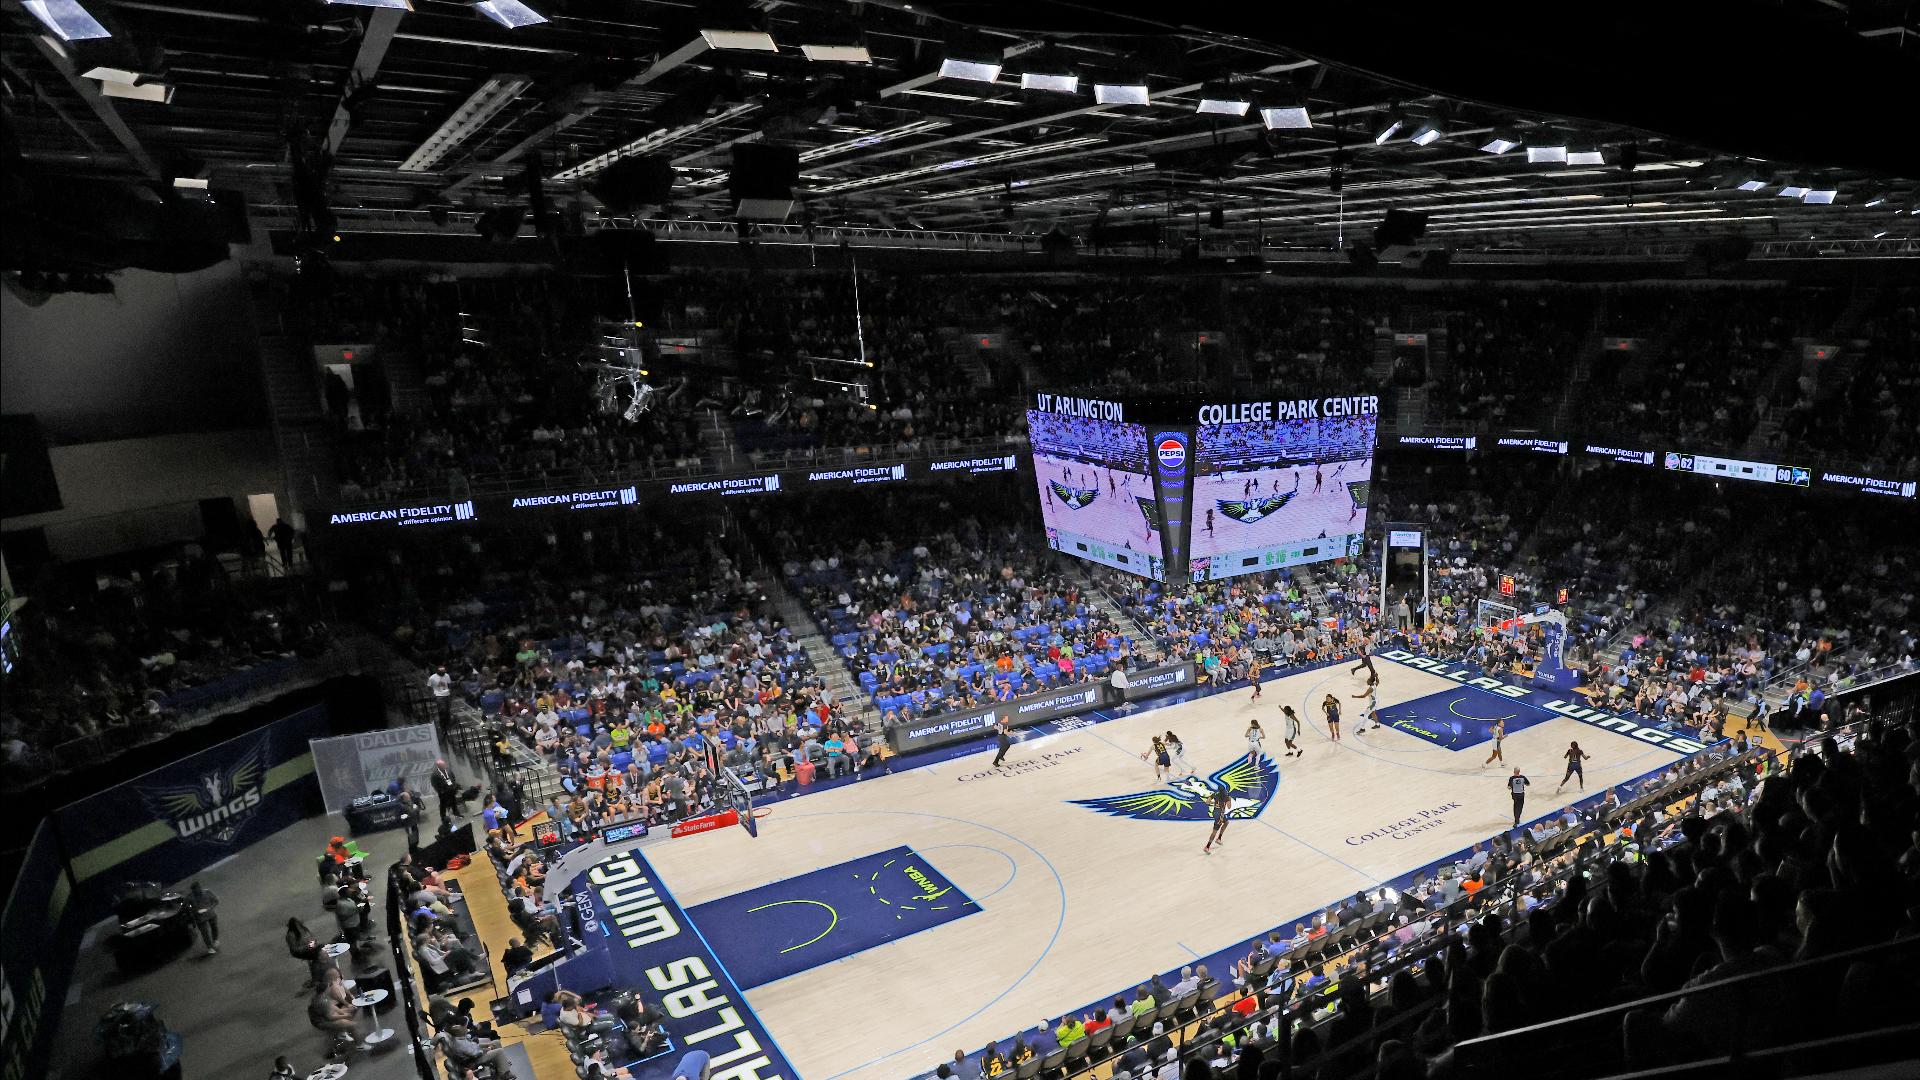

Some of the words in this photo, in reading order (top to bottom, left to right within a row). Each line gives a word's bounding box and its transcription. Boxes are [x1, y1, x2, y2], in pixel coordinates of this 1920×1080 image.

[1037, 394, 1052, 412] UT
[1055, 396, 1123, 422] ARLINGTON
[1199, 402, 1272, 425] COLLEGE
[1278, 399, 1319, 420] PARK
[1323, 395, 1378, 417] CENTER
[1400, 436, 1434, 446] AMERICAN
[1435, 437, 1464, 446] FIDELITY
[1497, 438, 1533, 446] AMERICAN
[1534, 439, 1559, 448] FIDELITY
[1585, 445, 1617, 455] AMERICAN
[1617, 448, 1644, 458] FIDELITY
[931, 460, 971, 471] AMERICAN
[971, 457, 1003, 467] FIDELITY
[1680, 457, 1693, 469] 62
[809, 470, 853, 481] AMERICAN
[854, 467, 890, 477] FIDELITY
[1777, 468, 1791, 481] 60
[1822, 473, 1864, 486] AMERICAN
[1865, 478, 1901, 490] FIDELITY
[671, 481, 722, 494] AMERICAN
[722, 478, 762, 489] FIDELITY
[513, 494, 570, 508] AMERICAN
[571, 490, 618, 502] FIDELITY
[330, 510, 397, 525] AMERICAN
[399, 505, 452, 518] FIDELITY
[431, 516, 453, 524] opinion
[1502, 583, 1512, 594] 20
[1149, 672, 1175, 684] FIDELITY
[1380, 650, 1533, 697] DALLAS
[1018, 700, 1055, 713] AMERICAN
[1055, 693, 1084, 705] FIDELITY
[909, 724, 949, 739] AMERICAN
[951, 716, 983, 730] FIDELITY
[1542, 699, 1709, 754] WINGS
[360, 726, 432, 749] DALLAS
[957, 758, 1040, 782] COLLEGE
[1042, 746, 1084, 761] PARK
[1003, 761, 1062, 778] CENTER
[177, 786, 260, 838] WINGS
[1345, 817, 1421, 846] COLLEGE
[1416, 801, 1463, 819] PARK
[1392, 819, 1446, 840] CENTER
[903, 865, 939, 894] WNBA
[575, 890, 595, 921] GEM
[588, 851, 681, 949] WING
[645, 956, 784, 1080] ALLAS
